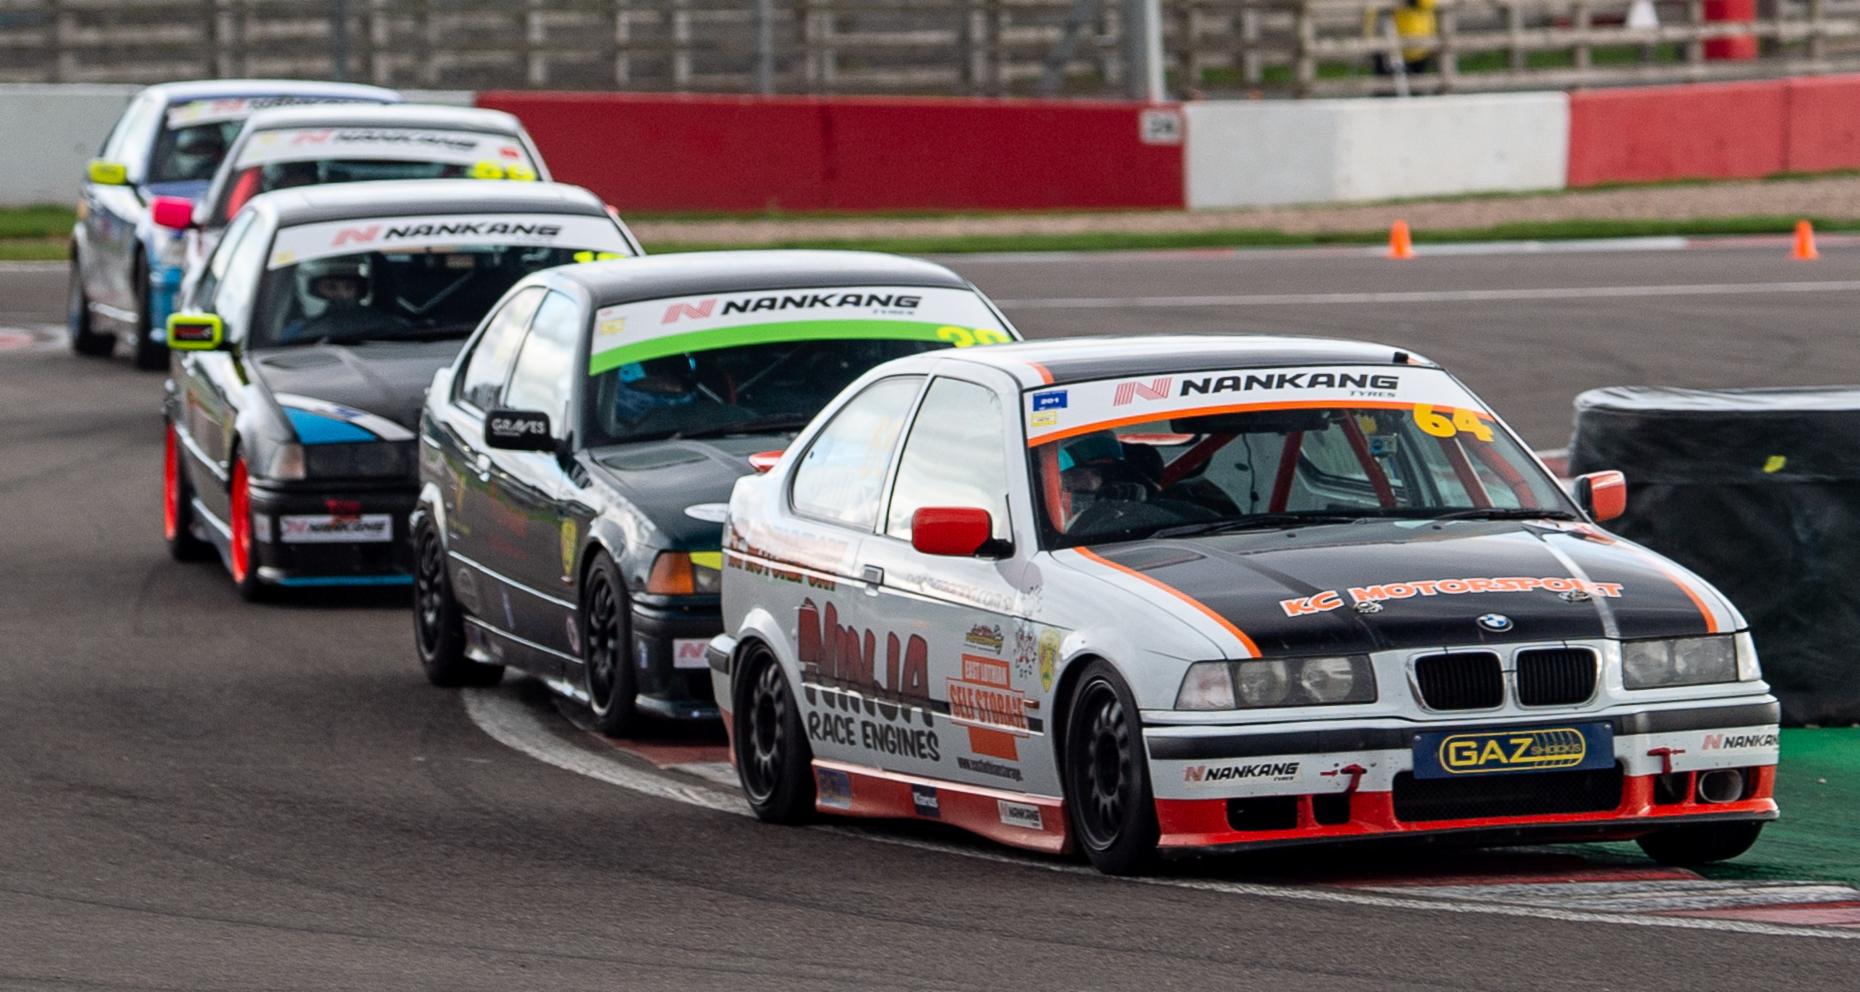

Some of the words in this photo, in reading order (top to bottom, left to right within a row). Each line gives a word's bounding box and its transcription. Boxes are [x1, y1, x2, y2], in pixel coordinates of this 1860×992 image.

[384, 222, 563, 239] NANKANG
[720, 293, 922, 315] NANKANG
[1180, 373, 1399, 396] NANKANG
[1349, 390, 1396, 398] TYRES
[491, 418, 547, 434] GRAVES
[1413, 403, 1494, 442] 64
[1279, 590, 1344, 617] KC
[1348, 577, 1623, 604] MOTORSPORT
[798, 597, 934, 728] NINJA
[950, 684, 975, 721] SELF
[808, 710, 857, 746] RACE
[861, 720, 941, 762] ENGINES
[1449, 738, 1534, 767] GAZ
[1205, 762, 1300, 781] NANKANG
